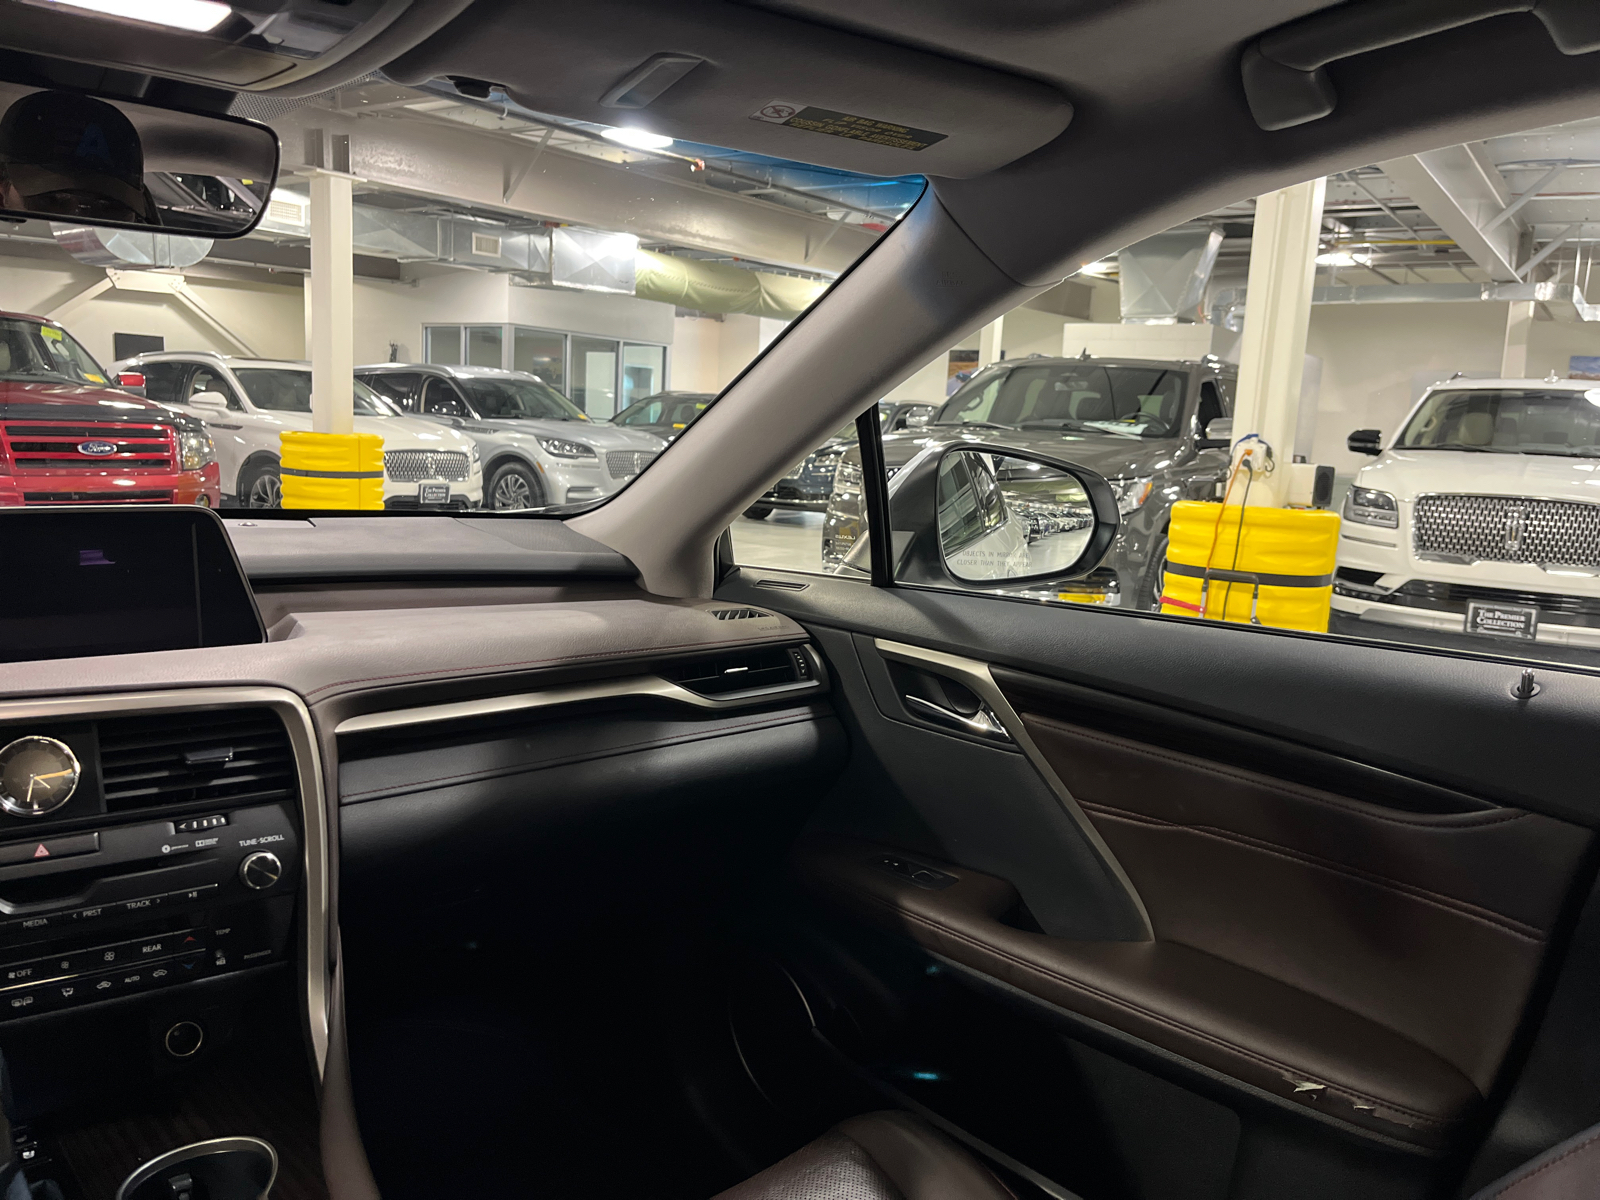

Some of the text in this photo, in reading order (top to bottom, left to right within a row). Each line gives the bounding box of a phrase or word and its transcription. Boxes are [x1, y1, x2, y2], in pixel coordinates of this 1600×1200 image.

[1477, 608, 1526, 622] THE PREMIER
[1476, 616, 1526, 629] COLLECTION
[126, 899, 151, 909] TRACK
[82, 908, 102, 918] PRST
[22, 918, 48, 928] MEDIA
[142, 943, 162, 953] REAR
[16, 968, 33, 978] OFF
[124, 975, 140, 983] AUTO
